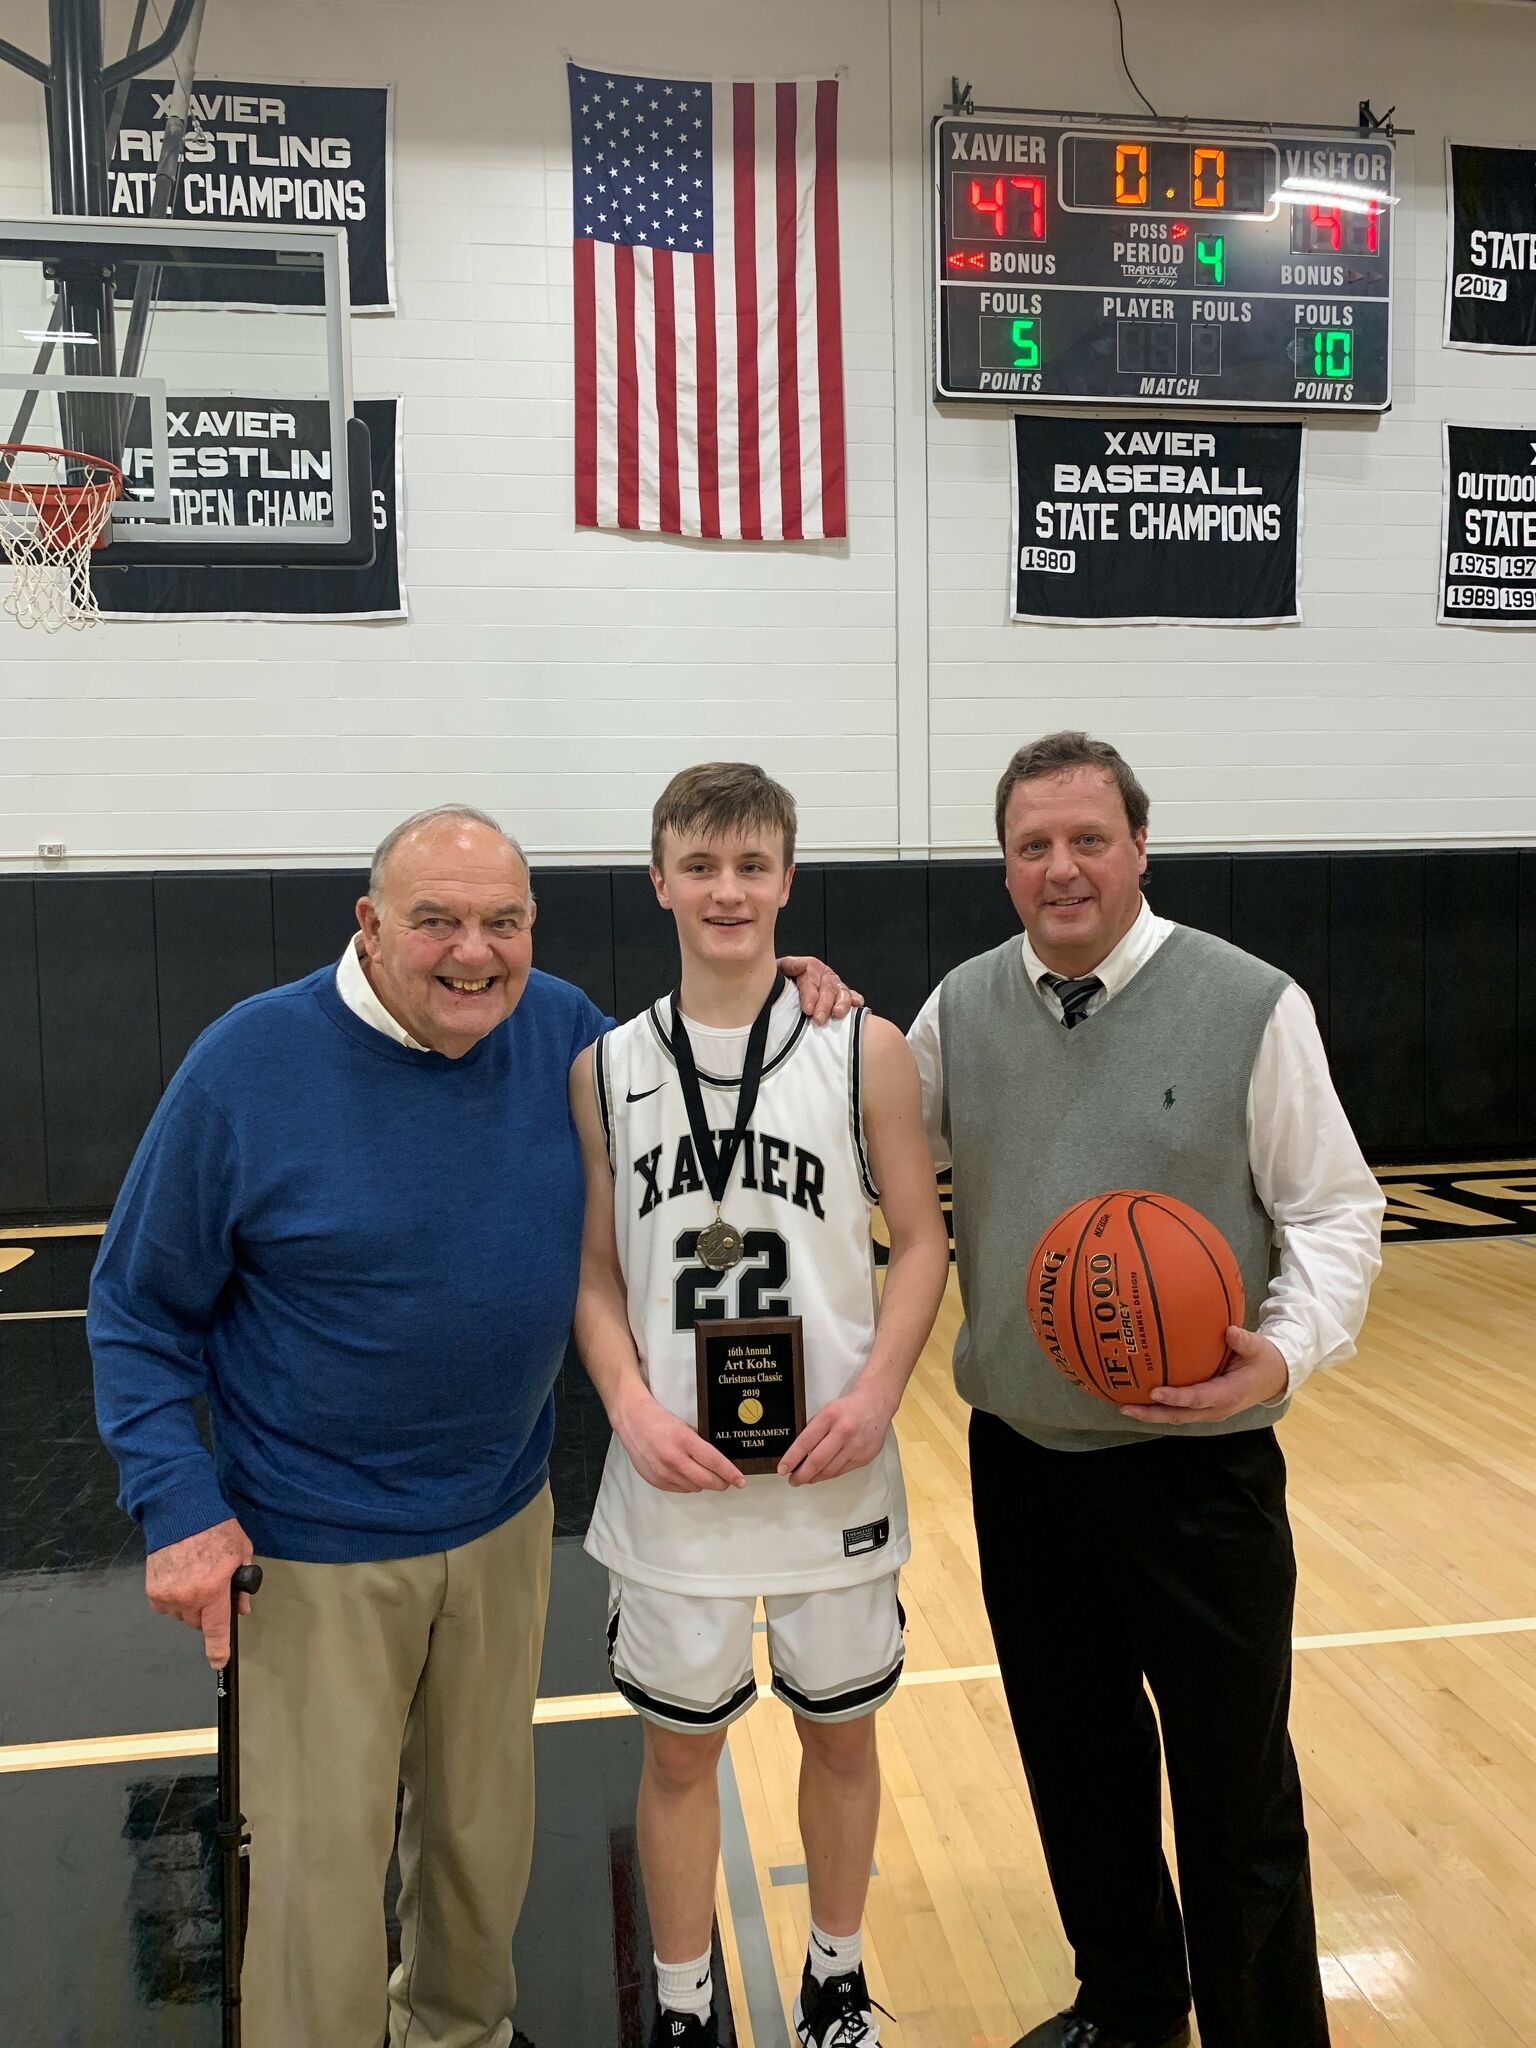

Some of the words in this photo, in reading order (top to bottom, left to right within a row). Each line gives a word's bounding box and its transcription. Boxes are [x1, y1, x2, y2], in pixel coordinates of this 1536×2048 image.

[951, 132, 1047, 164] XAVIER
[1286, 150, 1386, 181] VISITOR
[184, 173, 366, 221] CHAMPIONS
[971, 177, 1043, 238] 47
[1129, 223, 1168, 239] POSS
[989, 252, 1056, 274] BONUS
[1113, 242, 1184, 264] PERIOD
[1197, 238, 1223, 283] 4
[1136, 276, 1178, 287] Fair-Play
[1281, 265, 1344, 286] BONUS
[1459, 276, 1502, 299] 2017
[980, 293, 1043, 314] FOULS
[1103, 297, 1175, 319] PLAYER
[1192, 301, 1252, 322] FOULS
[1294, 305, 1354, 326] FOULS
[1012, 320, 1039, 368] 5
[1314, 331, 1351, 377] 10
[979, 372, 1042, 392] POINTS
[1139, 377, 1201, 397] MATCH
[1294, 382, 1354, 402] POINTS
[167, 410, 297, 439] XAVIER
[1104, 431, 1216, 458] XAVIER
[1054, 463, 1263, 495] BASEBALL
[1457, 472, 1536, 502] OUTDOO
[169, 488, 236, 526] OPEN
[1035, 501, 1119, 540] STATE
[1129, 502, 1281, 541] CHAMPIONS
[1465, 508, 1536, 547] STATE
[1025, 548, 1071, 571] 1980
[1454, 554, 1496, 575] 1975
[1505, 558, 1536, 577] 197
[1451, 587, 1495, 607] 1989
[1505, 590, 1536, 608] 199
[672, 1227, 792, 1334] 22
[1130, 1271, 1141, 1305] DESIGN
[1090, 1253, 1134, 1390] TF-1000
[1119, 1301, 1138, 1354] LEGACY
[1136, 1310, 1149, 1349] CHANNEL
[727, 1346, 743, 1357] 16th
[744, 1345, 771, 1356] Annual
[724, 1360, 743, 1370] Art
[746, 1357, 777, 1369] Kohs
[718, 1374, 756, 1384] Christmas
[757, 1372, 783, 1383] Classic
[742, 1388, 760, 1398] 2019
[716, 1431, 732, 1439] ALL
[732, 1428, 790, 1438] TOURNAMENT
[741, 1440, 765, 1448] TEAM
